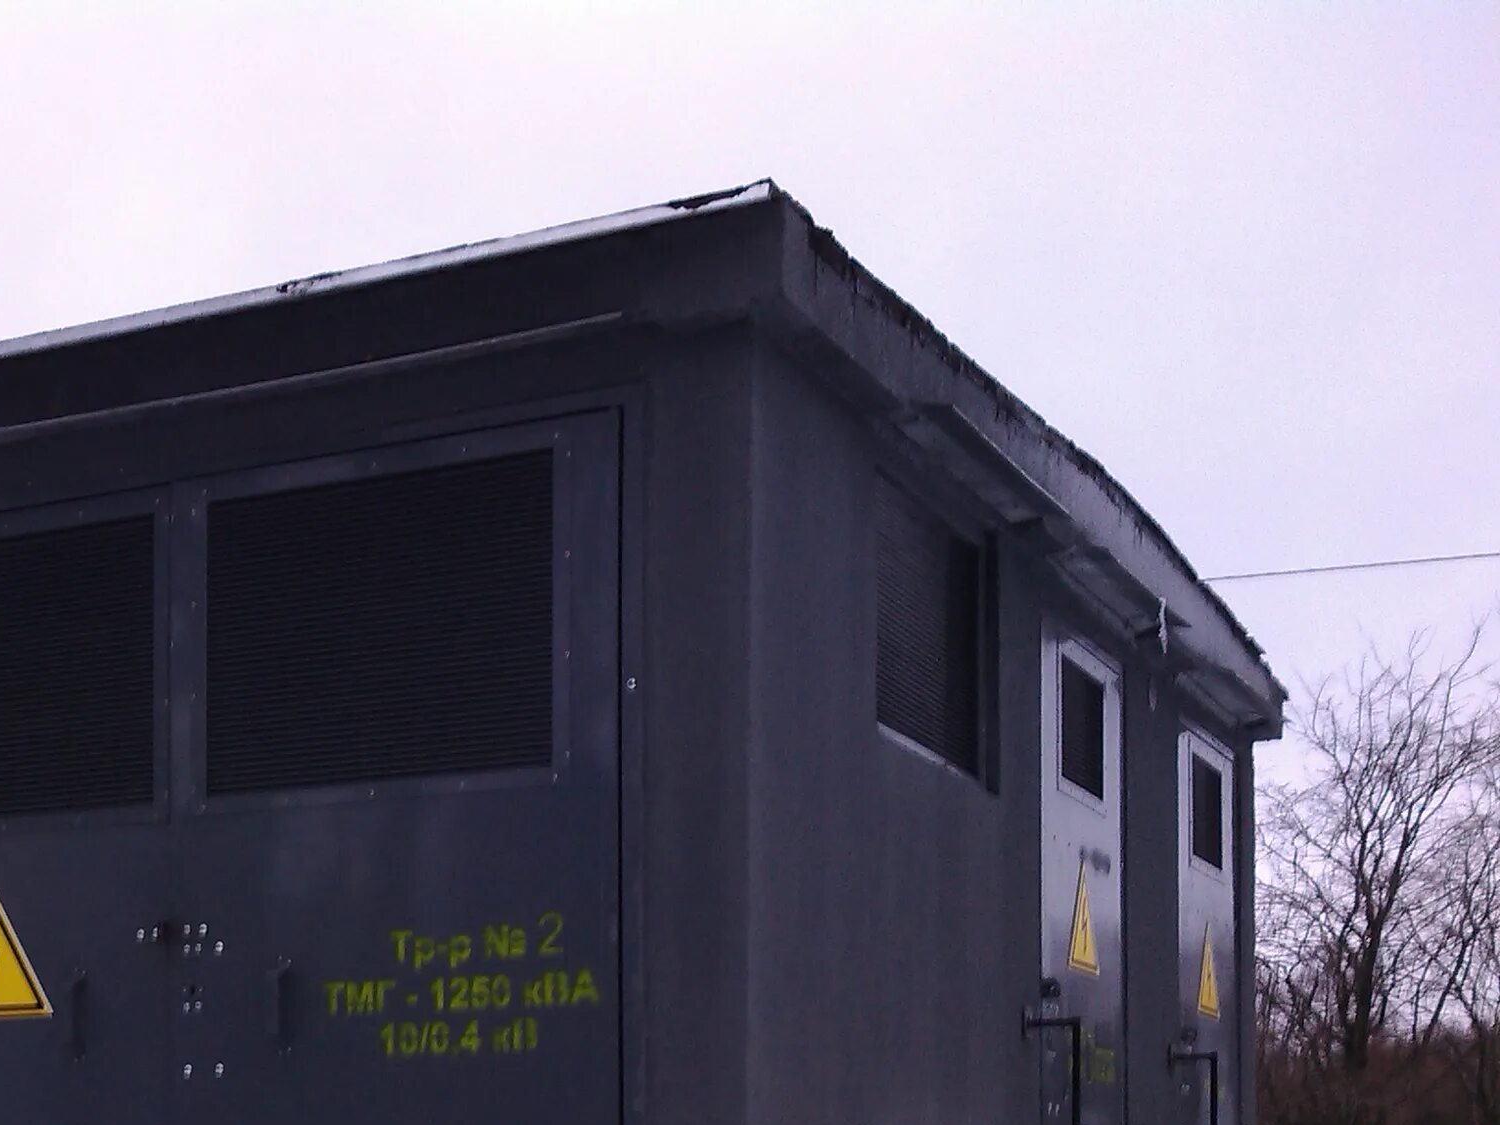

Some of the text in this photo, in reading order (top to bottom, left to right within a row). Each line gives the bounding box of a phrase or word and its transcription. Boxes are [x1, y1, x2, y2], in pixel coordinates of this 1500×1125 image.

[391, 910, 564, 970] Тр-р № 2
[326, 980, 396, 1015] ТМГ
[430, 973, 511, 1012] 1250
